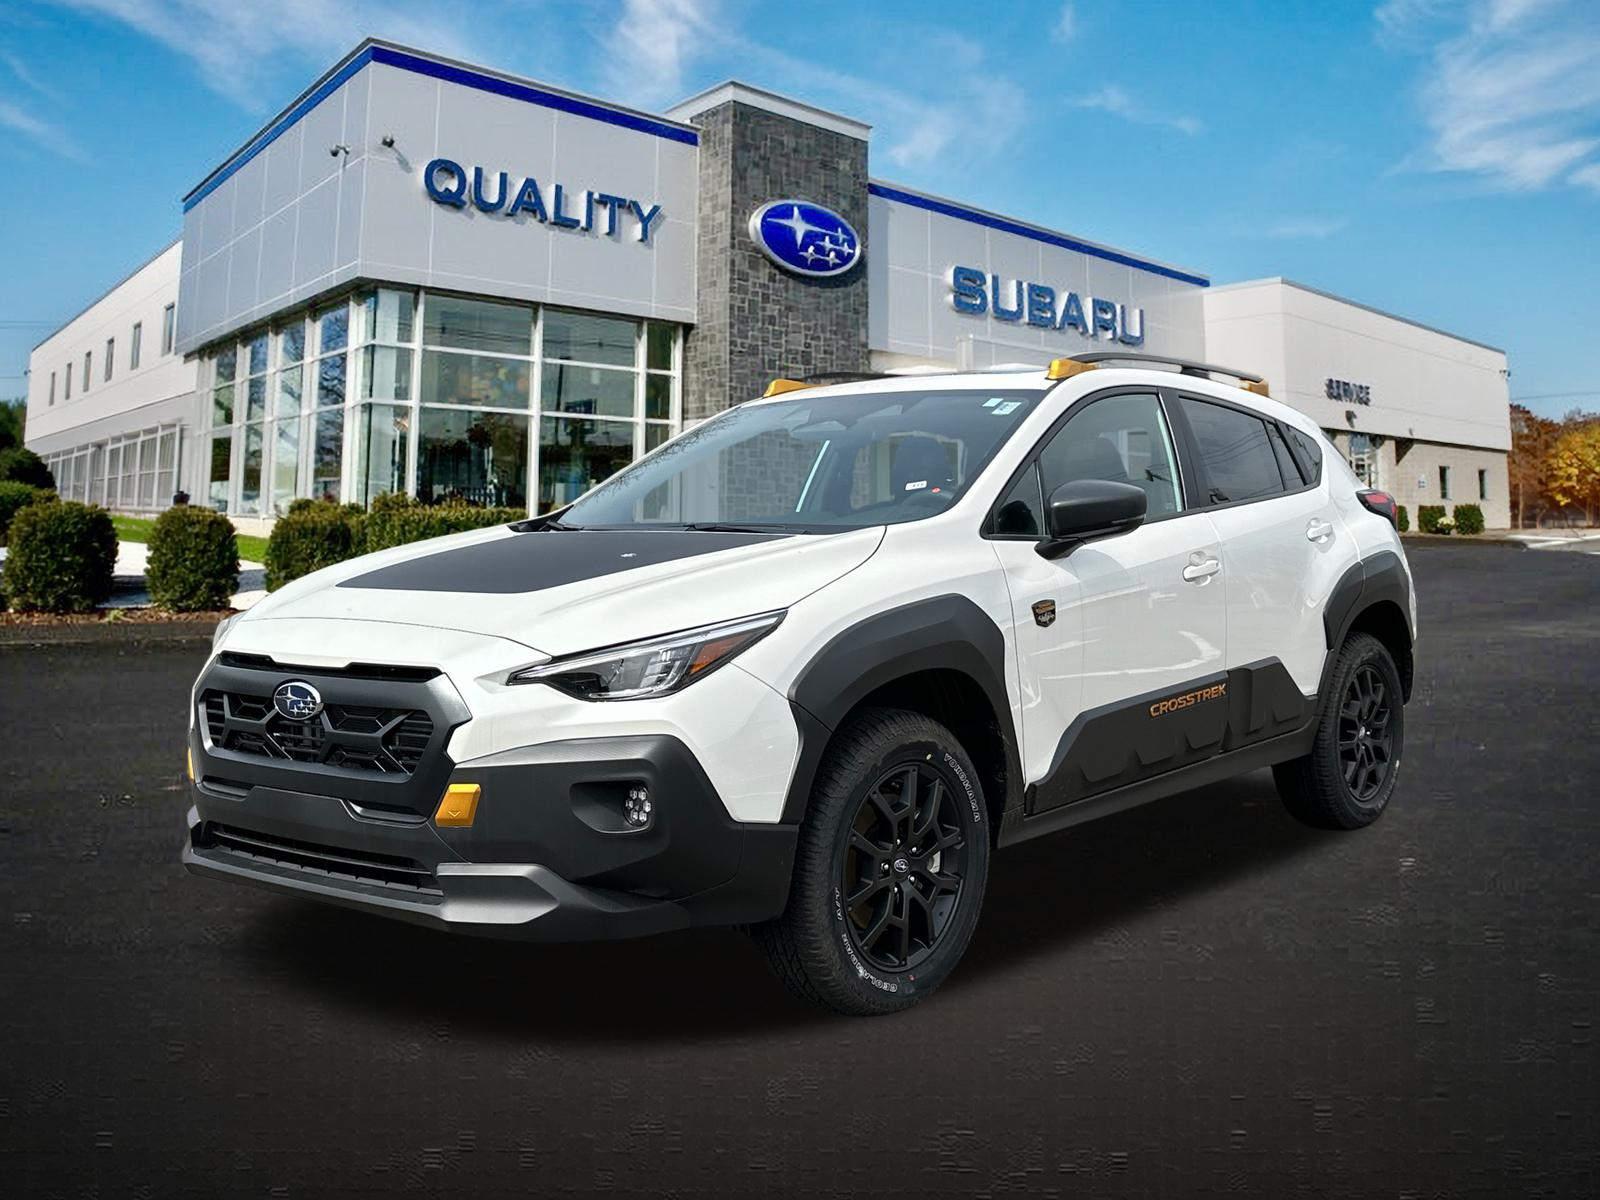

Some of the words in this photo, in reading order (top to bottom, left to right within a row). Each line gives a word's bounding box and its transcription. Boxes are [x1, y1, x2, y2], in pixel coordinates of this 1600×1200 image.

[424, 158, 661, 241] QUALITY
[949, 265, 1144, 345] SUBARU
[1325, 378, 1371, 406] SERVICE
[1150, 683, 1227, 717] CROSSTREK
[943, 752, 981, 823] YOKOHAMA
